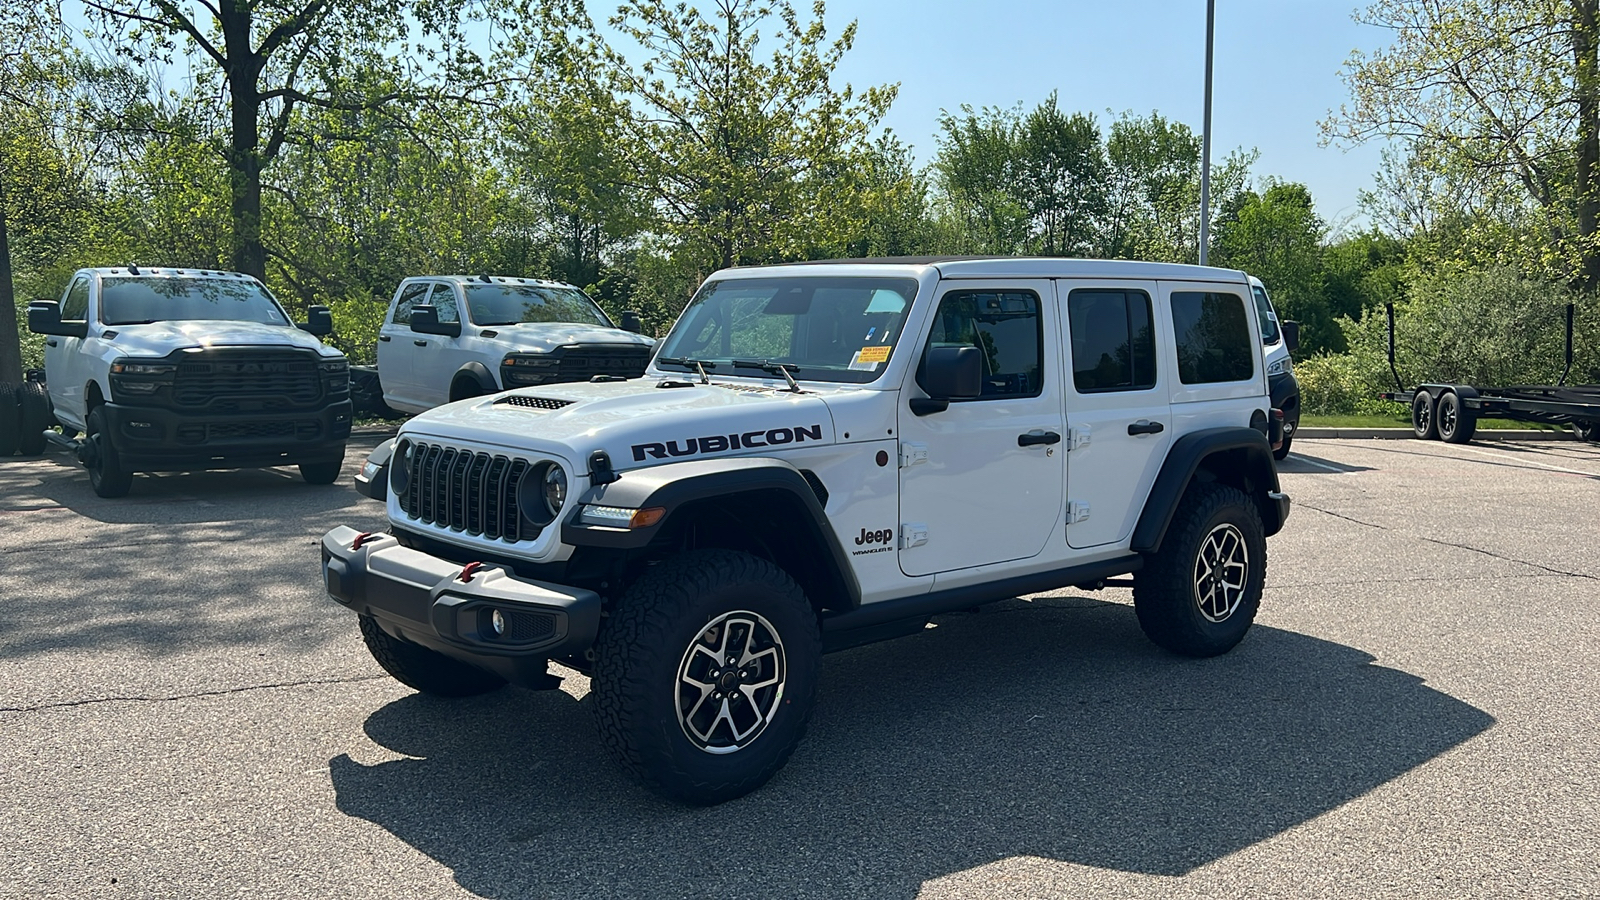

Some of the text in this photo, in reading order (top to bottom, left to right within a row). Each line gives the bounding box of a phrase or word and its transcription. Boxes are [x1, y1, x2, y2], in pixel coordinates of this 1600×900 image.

[216, 363, 286, 373] RAM
[589, 358, 640, 368] RAM
[631, 424, 822, 462] RUBICON
[854, 527, 893, 546] Jeep
[852, 547, 887, 556] WRANGLER
